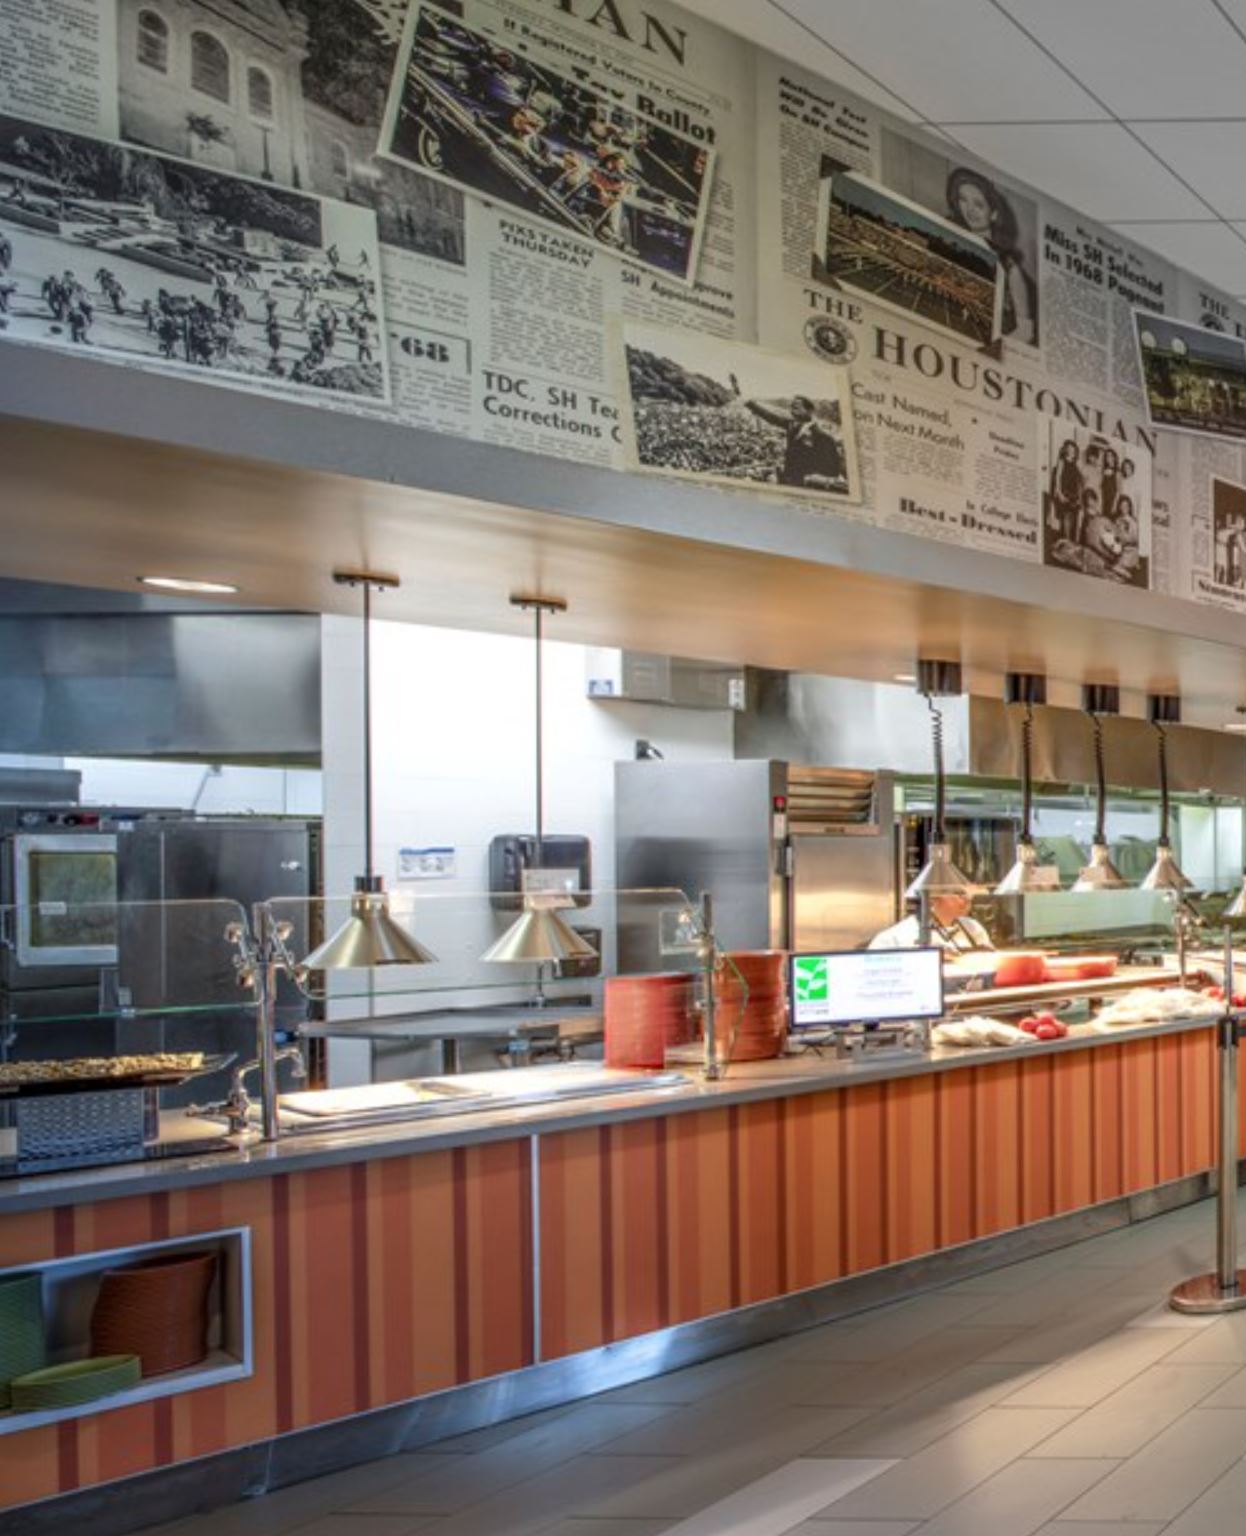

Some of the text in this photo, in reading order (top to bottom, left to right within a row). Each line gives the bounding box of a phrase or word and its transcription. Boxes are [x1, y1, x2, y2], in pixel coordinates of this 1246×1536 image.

[636, 94, 716, 145] Ballot
[502, 233, 592, 269] THURSDAY
[540, 233, 595, 258] TAKEN
[1044, 224, 1078, 254] Miss
[1083, 243, 1103, 266] SH
[1107, 255, 1163, 297] Selected
[621, 270, 640, 287] SH
[1045, 243, 1061, 265] In
[1065, 254, 1103, 286] 1968
[802, 288, 863, 325] THE
[1200, 294, 1230, 320] THE
[547, 385, 577, 410] SH
[873, 325, 1158, 457] HOUSTONIAN
[482, 396, 602, 438] Corrections
[918, 426, 965, 450] Month
